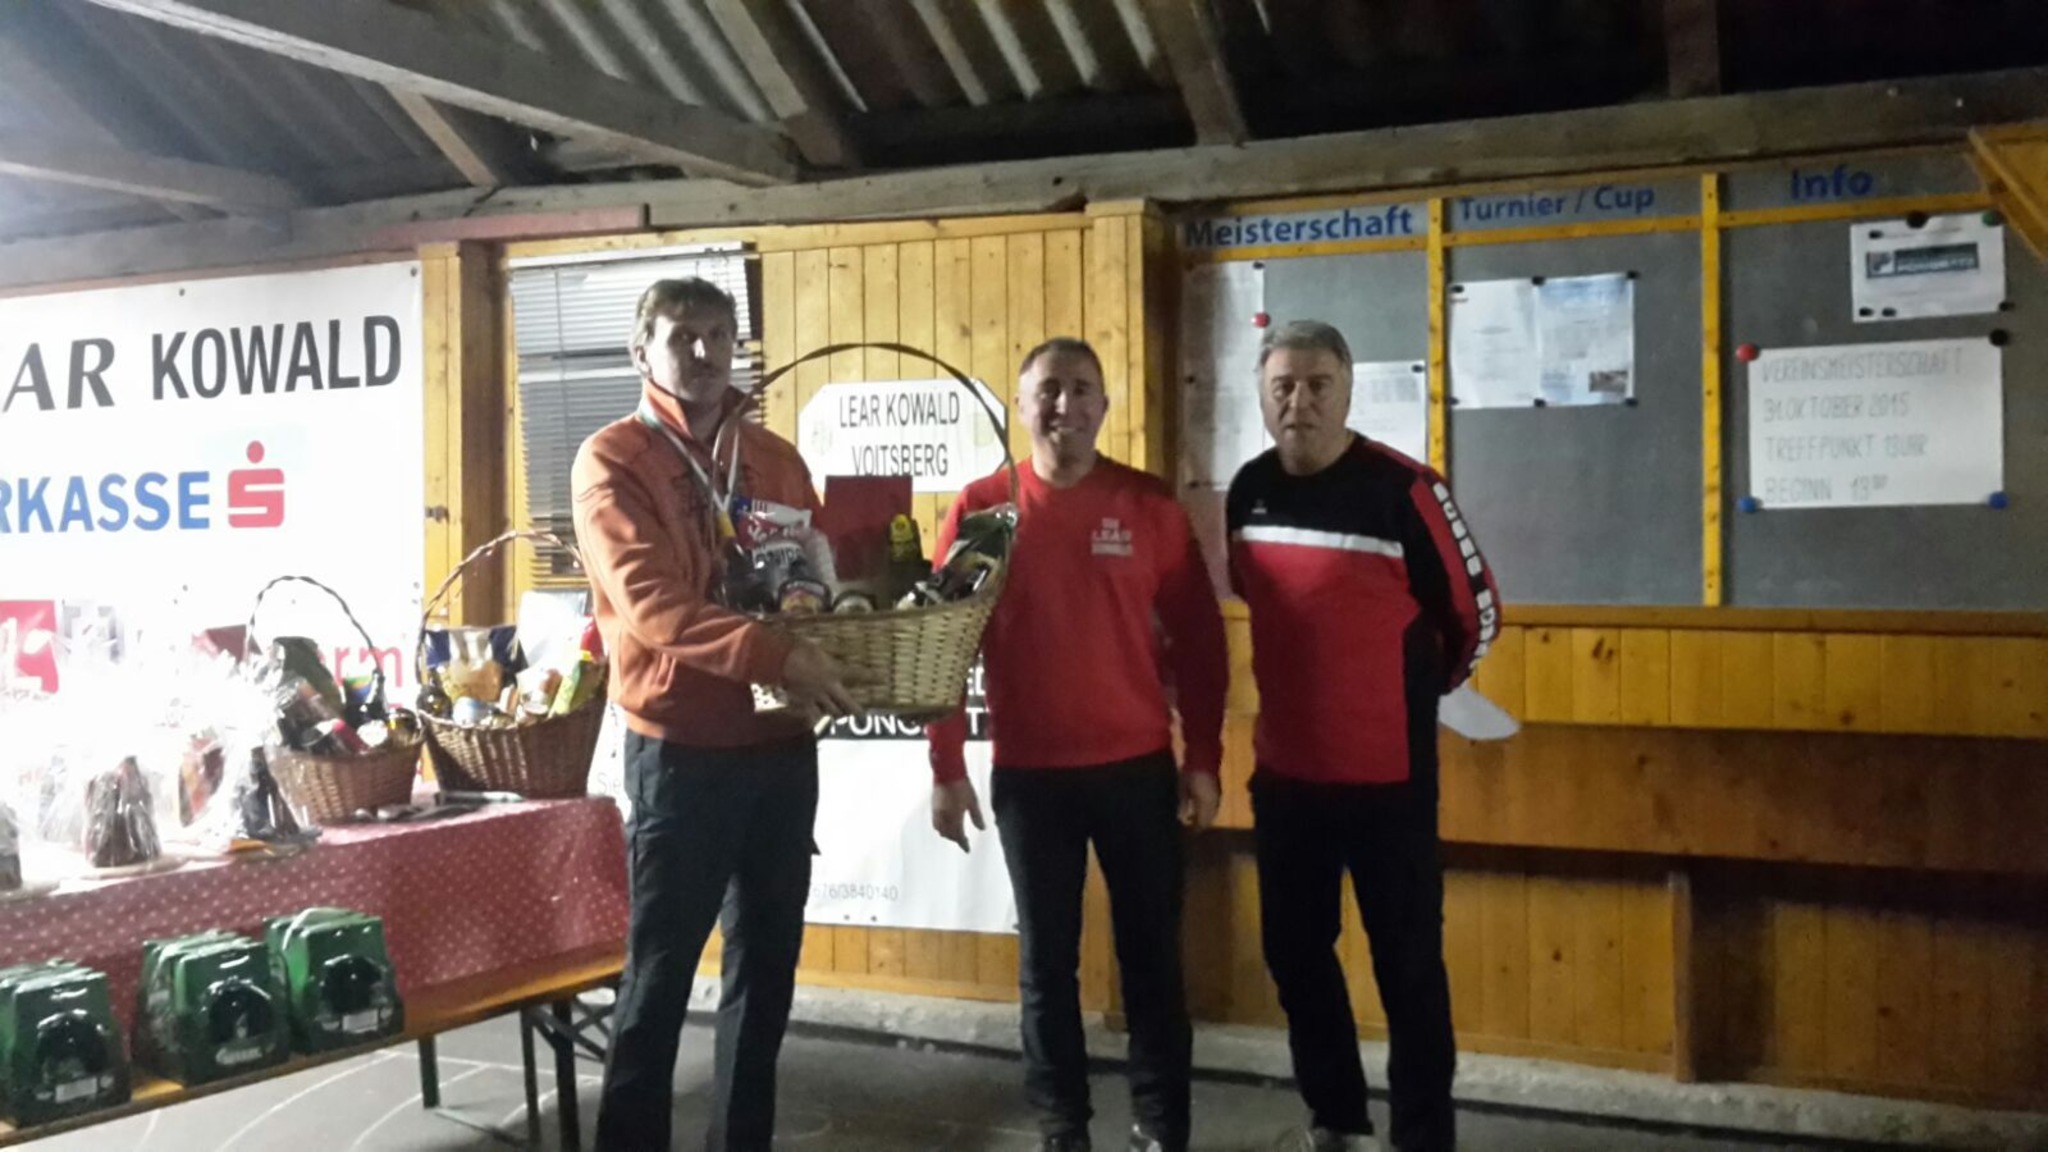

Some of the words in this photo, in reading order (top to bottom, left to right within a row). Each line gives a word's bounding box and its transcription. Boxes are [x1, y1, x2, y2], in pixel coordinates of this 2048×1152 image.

[1791, 165, 1874, 198] Info
[1459, 191, 1563, 221] Turnier
[1594, 187, 1655, 213] Cup
[1185, 207, 1411, 247] Meisterschaft
[2, 338, 115, 412] AR
[151, 315, 401, 400] KOWALD
[840, 395, 880, 428] LEAR
[886, 391, 960, 427] KOWALD
[852, 444, 948, 476] VOITSBERG
[1764, 434, 1875, 461] TREFFPUNKT
